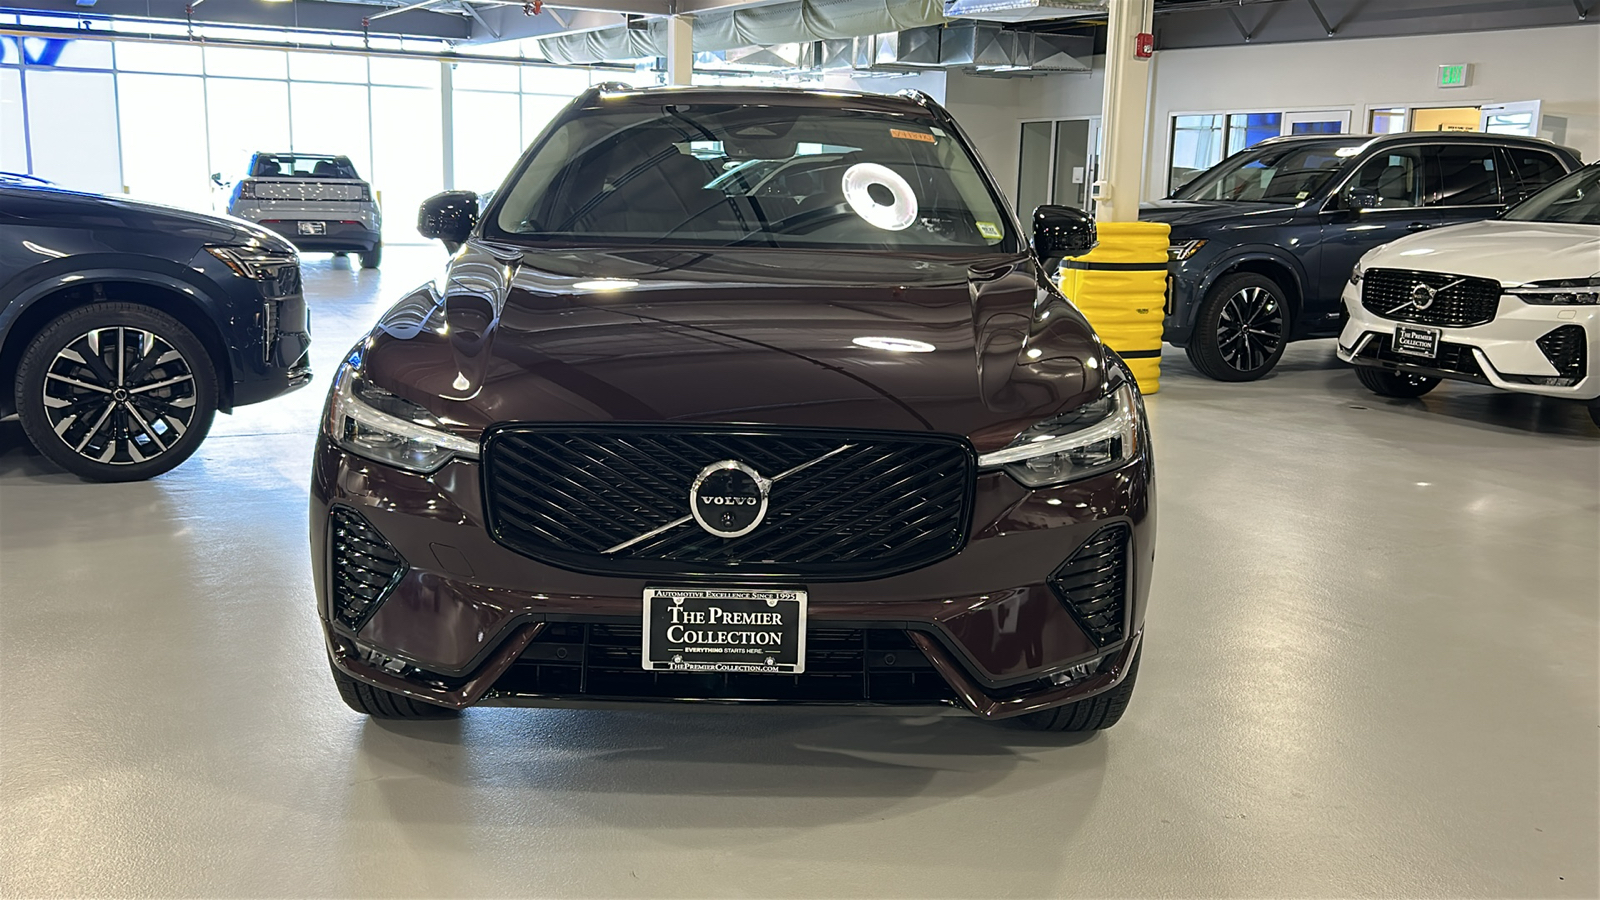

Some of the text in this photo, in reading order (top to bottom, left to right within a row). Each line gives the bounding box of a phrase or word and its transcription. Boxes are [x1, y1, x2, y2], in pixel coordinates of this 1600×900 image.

[1442, 66, 1463, 84] EXIT
[701, 496, 757, 506] VOLVO
[667, 606, 783, 626] THE PREMIER
[666, 625, 783, 645] COLLECTION
